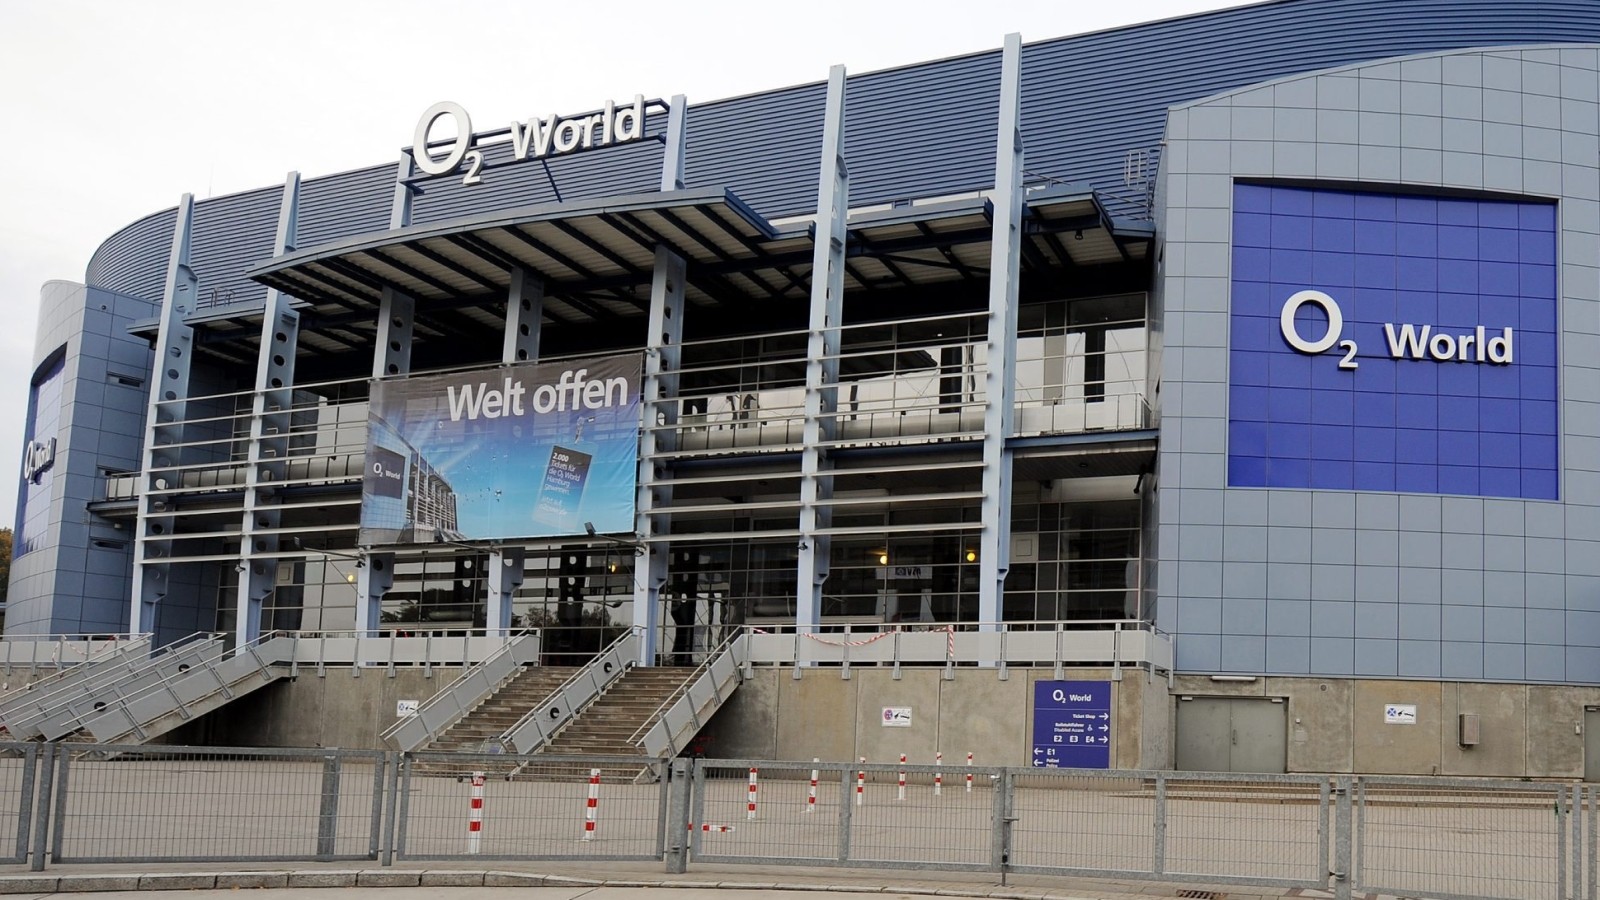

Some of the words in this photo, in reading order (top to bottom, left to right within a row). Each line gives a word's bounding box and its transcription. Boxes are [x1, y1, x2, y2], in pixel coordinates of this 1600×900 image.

[413, 101, 485, 186] O2
[510, 94, 646, 160] World
[1280, 290, 1358, 368] O2
[1384, 323, 1513, 364] World
[447, 377, 525, 421] Welt
[533, 369, 628, 415] offen
[552, 452, 569, 462] 2.000
[373, 462, 384, 478] O2
[385, 469, 401, 480] World
[551, 460, 567, 470] Tickets
[568, 463, 577, 472] für
[548, 467, 557, 475] die
[564, 471, 581, 482] World
[546, 475, 571, 488] Hamburg
[1053, 689, 1066, 703] O2
[1069, 694, 1092, 702] World
[1053, 735, 1063, 743] E2
[1069, 735, 1079, 743] E3
[1085, 735, 1095, 743] E4
[1047, 748, 1056, 756] E1
